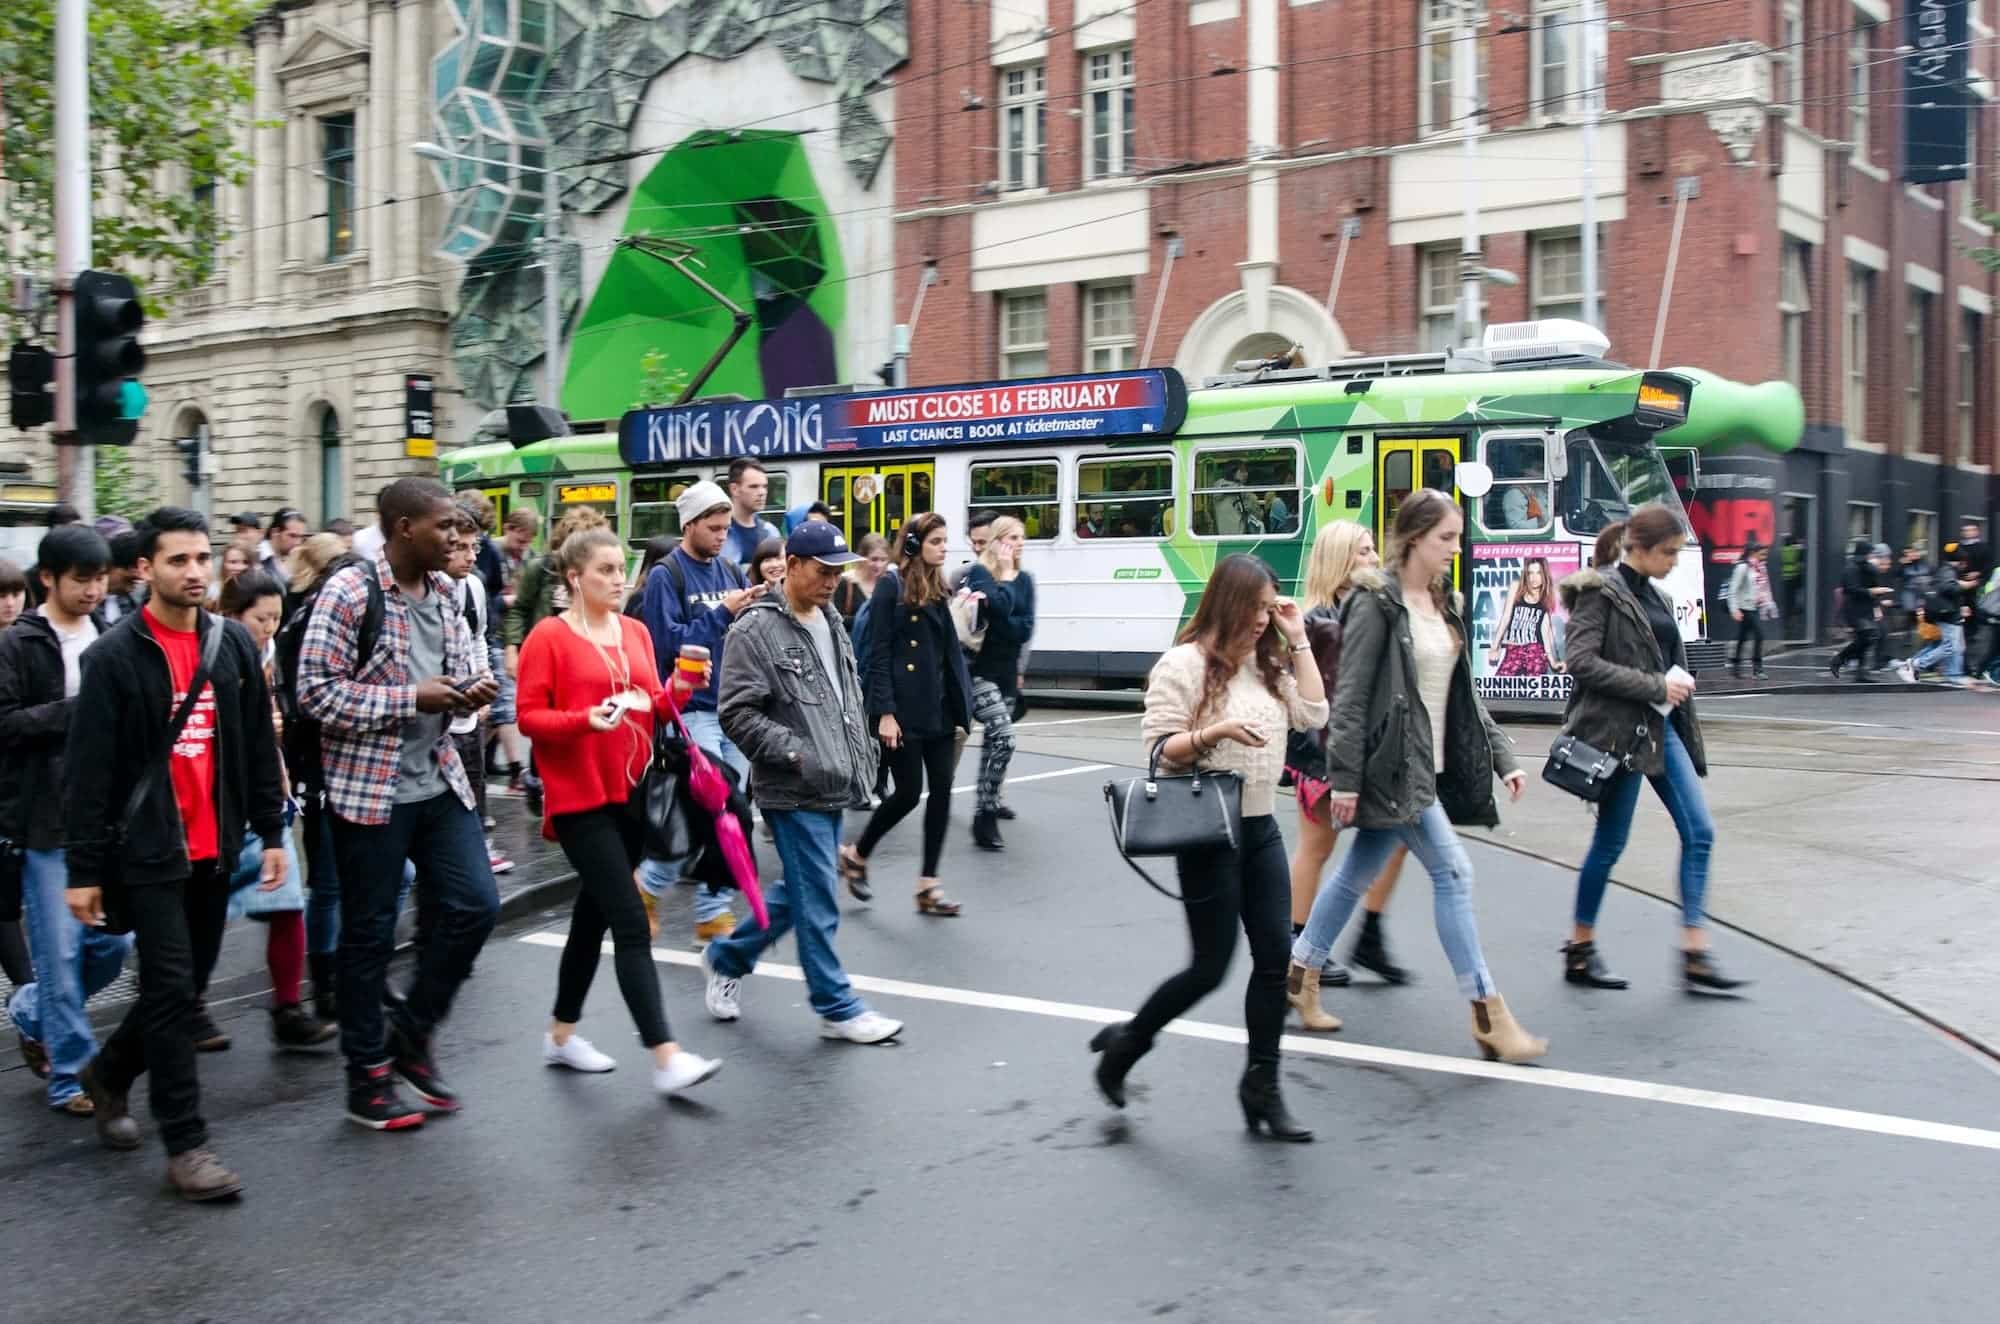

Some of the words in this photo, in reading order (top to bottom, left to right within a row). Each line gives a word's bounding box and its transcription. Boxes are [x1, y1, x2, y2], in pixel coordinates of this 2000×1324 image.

[868, 399, 918, 423] MUST
[922, 394, 984, 419] CLOSE
[990, 391, 1011, 414] 16
[1017, 383, 1120, 412] FEBRUARY
[648, 411, 711, 461] KING
[724, 402, 823, 455] KONG
[883, 429, 908, 443] LAST
[910, 426, 963, 442] CHANCE!
[969, 423, 1004, 439] BOOK
[1007, 421, 1022, 436] AT
[1025, 417, 1099, 433] ticketmaster
[1474, 545, 1532, 556] running
[1475, 677, 1538, 690] RUNNING
